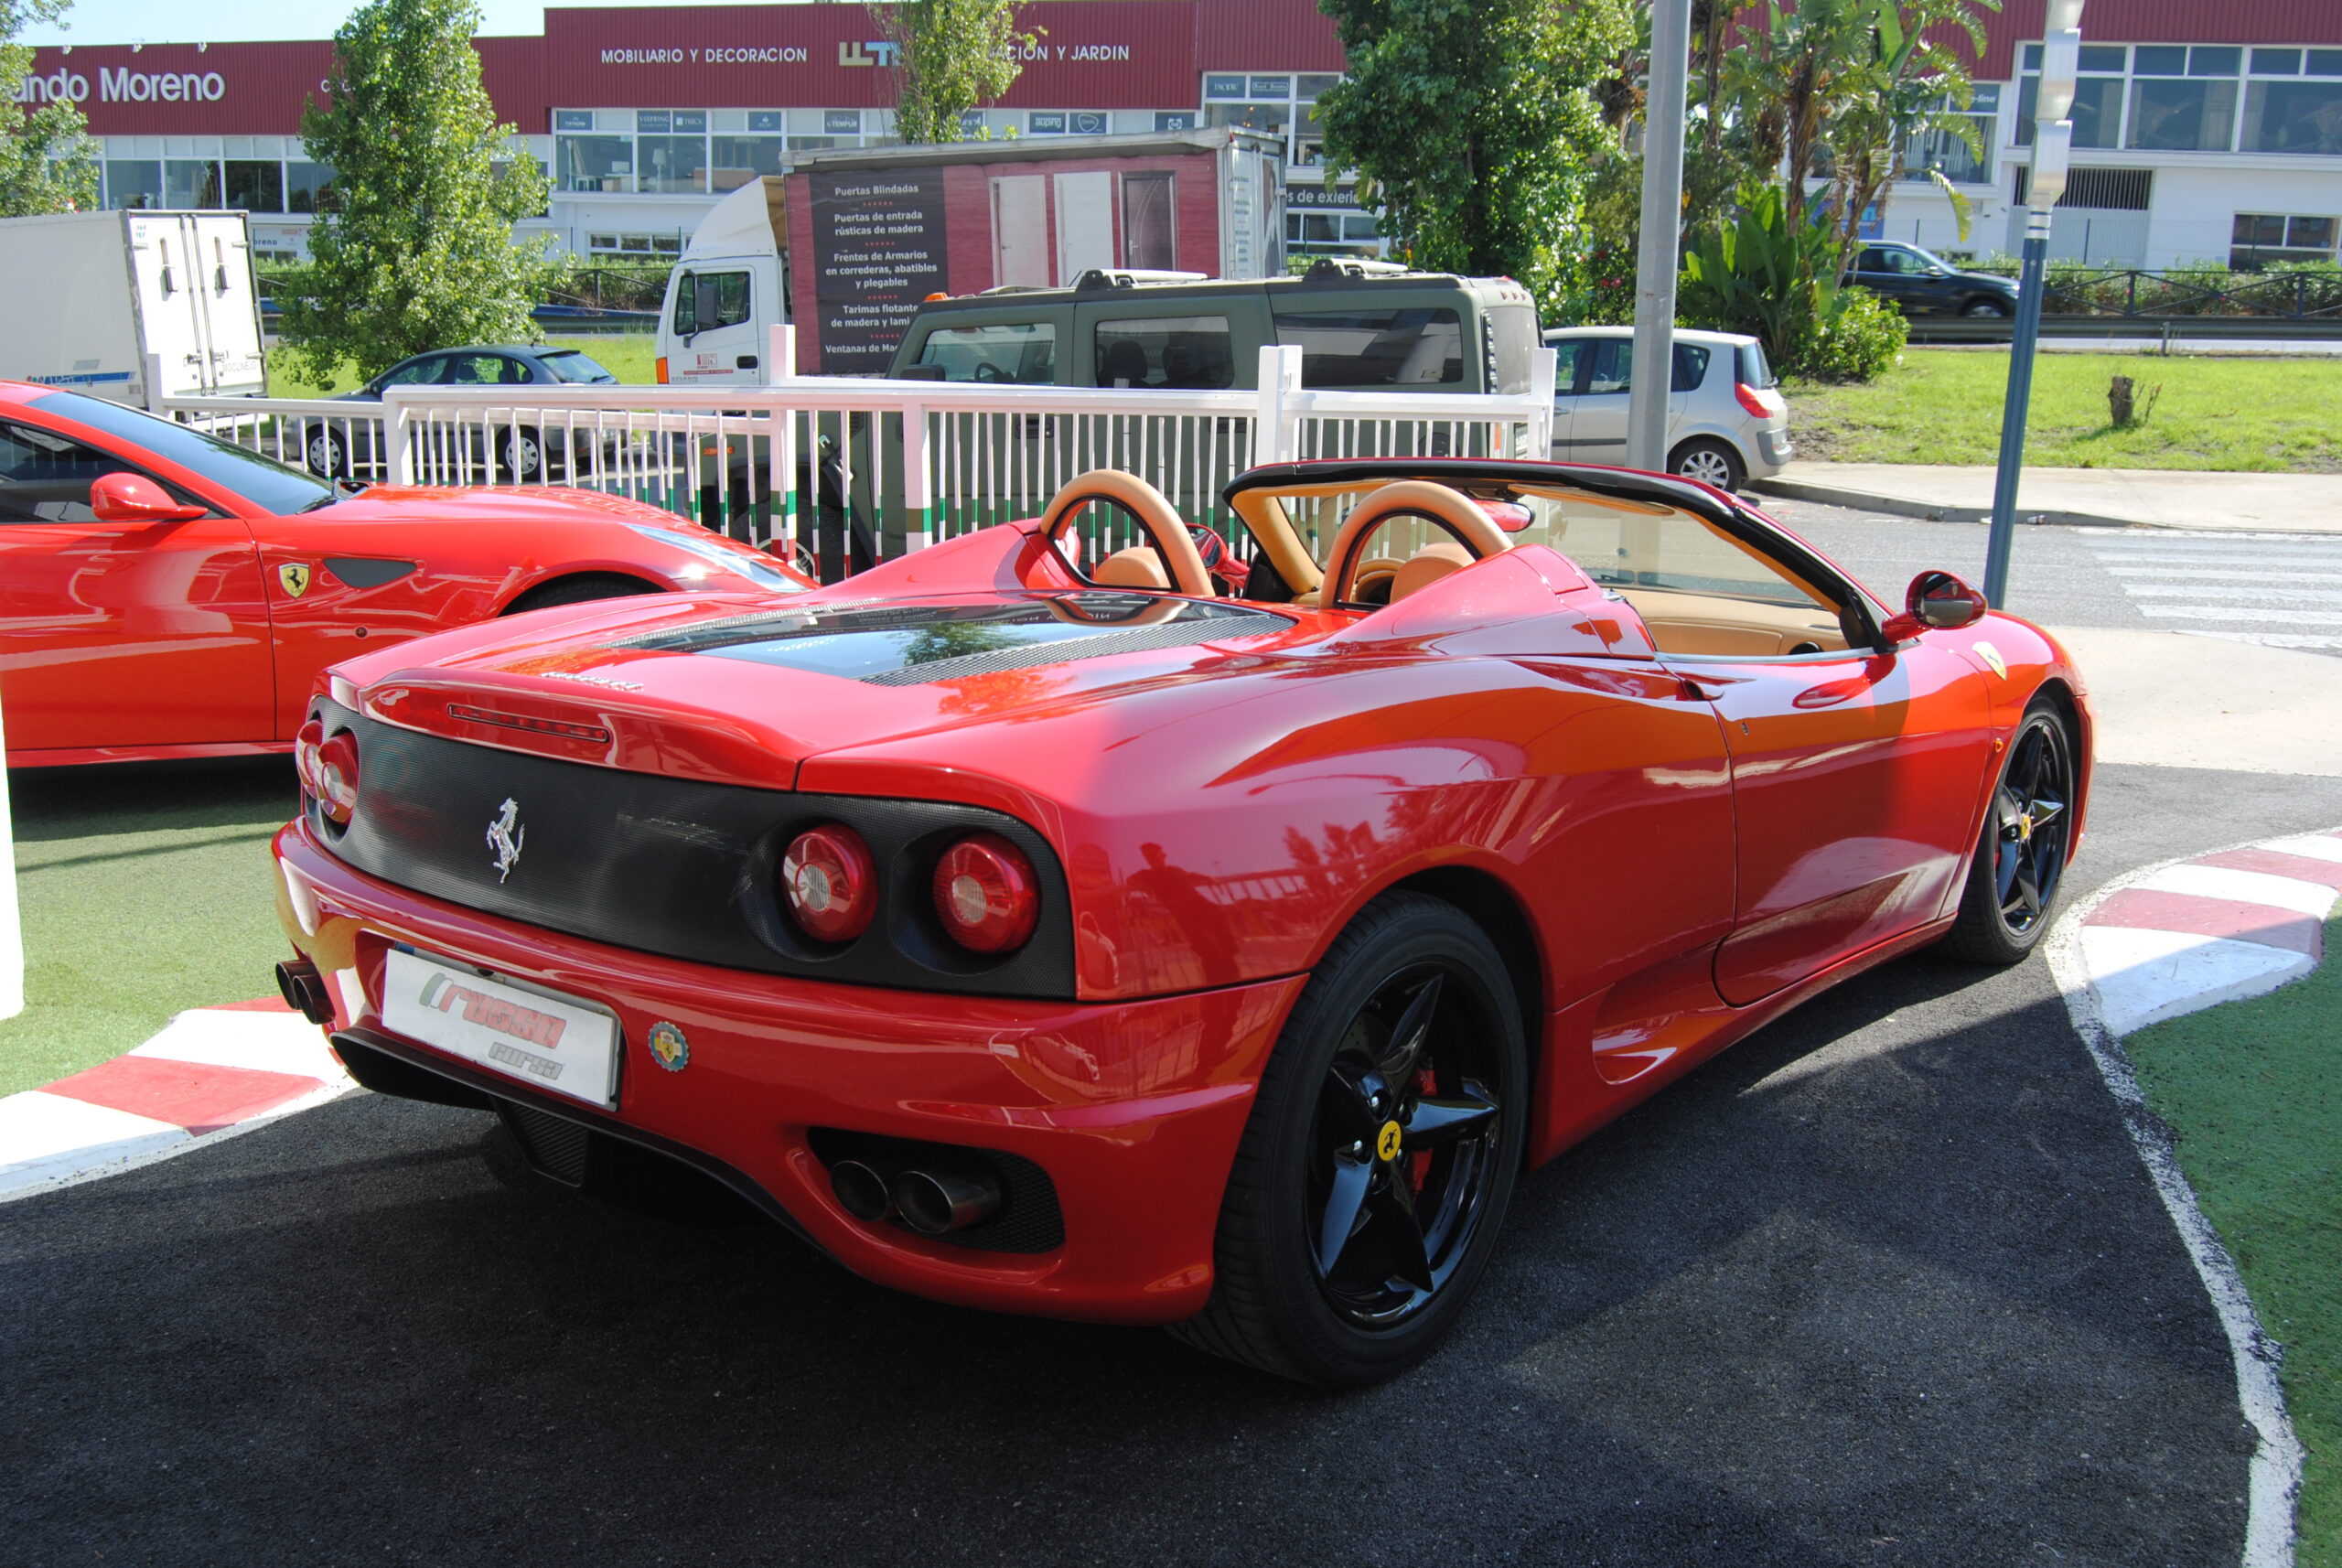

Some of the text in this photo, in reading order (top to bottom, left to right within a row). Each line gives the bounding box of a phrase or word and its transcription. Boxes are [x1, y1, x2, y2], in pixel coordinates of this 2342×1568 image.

[601, 47, 807, 63] MOBILIARIO Y DECORACION
[1057, 46, 1066, 60] Y
[1071, 45, 1129, 60] JARDIN
[100, 67, 226, 102] Moreno
[835, 184, 919, 196] Puertas Blindadas
[1297, 189, 1314, 202] de
[834, 210, 922, 222] Puertas de entrada
[835, 224, 923, 236] rústicas de madera
[834, 251, 928, 263] Frentes de Armarios
[840, 265, 892, 275] correderas,
[895, 263, 937, 273] abatibles
[855, 277, 908, 290] y plegables
[843, 305, 879, 314] Tarimas
[832, 318, 842, 328] de
[845, 317, 879, 327] madera
[882, 318, 887, 328] y
[825, 344, 866, 353] Ventanas
[869, 344, 879, 352] de
